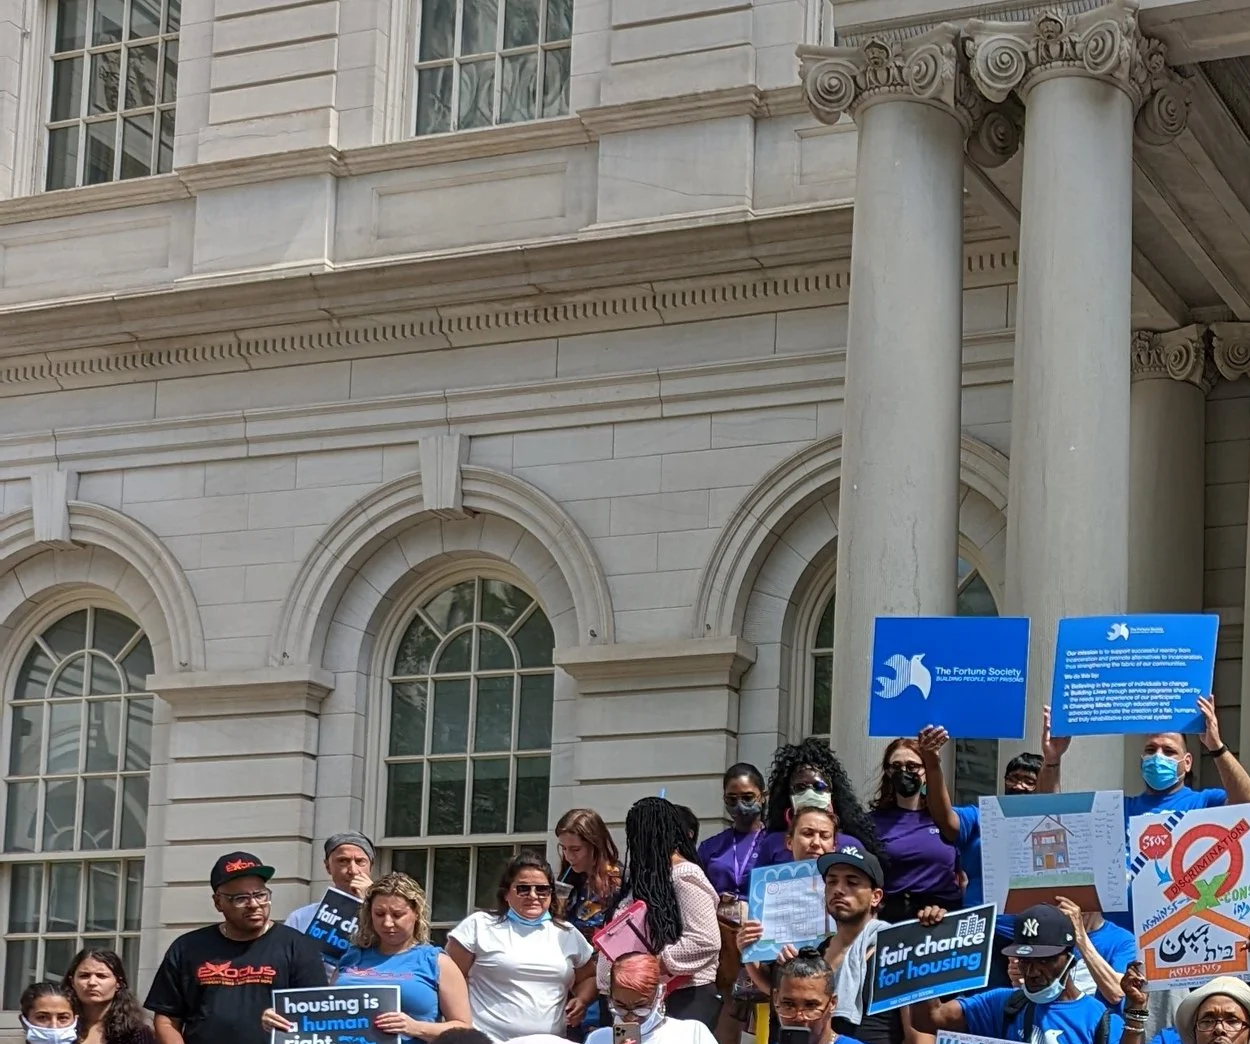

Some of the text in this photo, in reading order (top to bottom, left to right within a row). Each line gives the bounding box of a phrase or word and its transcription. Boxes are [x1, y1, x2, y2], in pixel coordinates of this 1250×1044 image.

[935, 666, 1022, 678] The Fortune Society
[1170, 823, 1245, 895] DISCRIMINATION
[317, 904, 343, 925] fair
[309, 920, 326, 938] for
[879, 931, 986, 968] fair chance
[878, 950, 982, 989] for housing
[284, 993, 379, 1015] housing is
[303, 1015, 369, 1033] human
